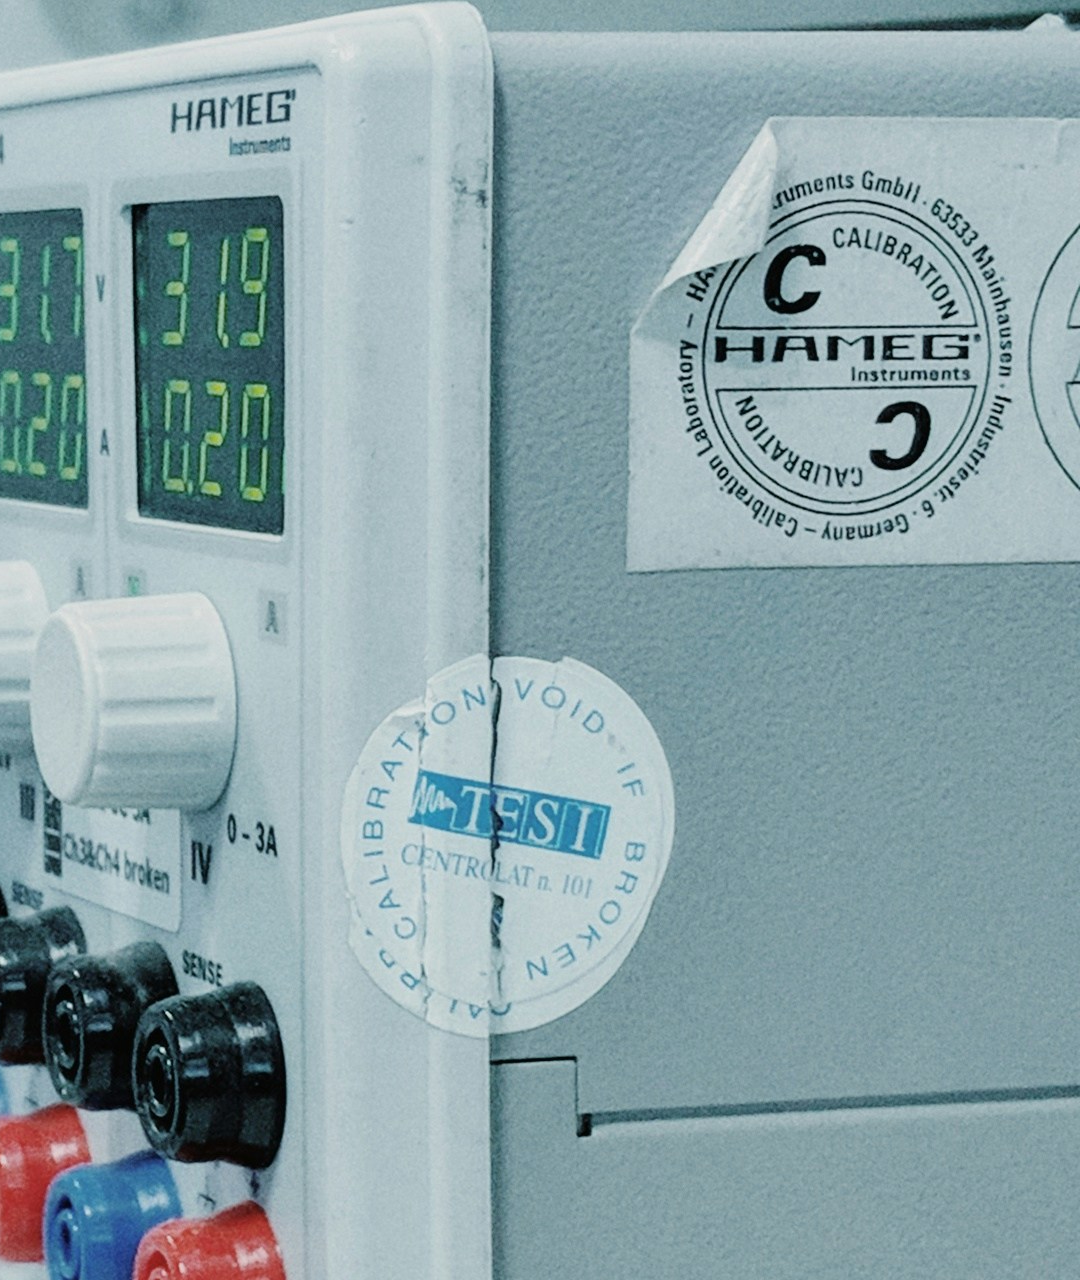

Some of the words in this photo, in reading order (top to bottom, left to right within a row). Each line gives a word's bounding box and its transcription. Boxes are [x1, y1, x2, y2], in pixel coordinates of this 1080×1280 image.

[169, 89, 292, 134] HAMEG
[229, 136, 292, 158] Instruments
[861, 170, 922, 205] GmbH
[930, 198, 980, 249] 63533
[95, 274, 106, 303] V
[763, 243, 827, 315] C
[832, 226, 961, 322] CALIBRATION
[970, 244, 1014, 378] Mainhausen
[713, 333, 971, 364] HAMEG
[850, 365, 971, 383] Instruments
[677, 340, 714, 459] Laboratory
[99, 427, 110, 457] A
[734, 395, 864, 489] CALIBRATION
[868, 400, 932, 472] C
[707, 454, 799, 538] Calibration
[922, 499, 936, 519] 6
[820, 513, 911, 541] Germany
[513, 677, 606, 734] VOID
[616, 761, 645, 798] IF
[227, 812, 237, 845] 0
[255, 821, 278, 858] 3A
[458, 784, 597, 853] TESI
[124, 849, 170, 895] broken
[190, 839, 213, 886] IV
[525, 841, 647, 981] BROKEN
[182, 948, 224, 988] SENSE
